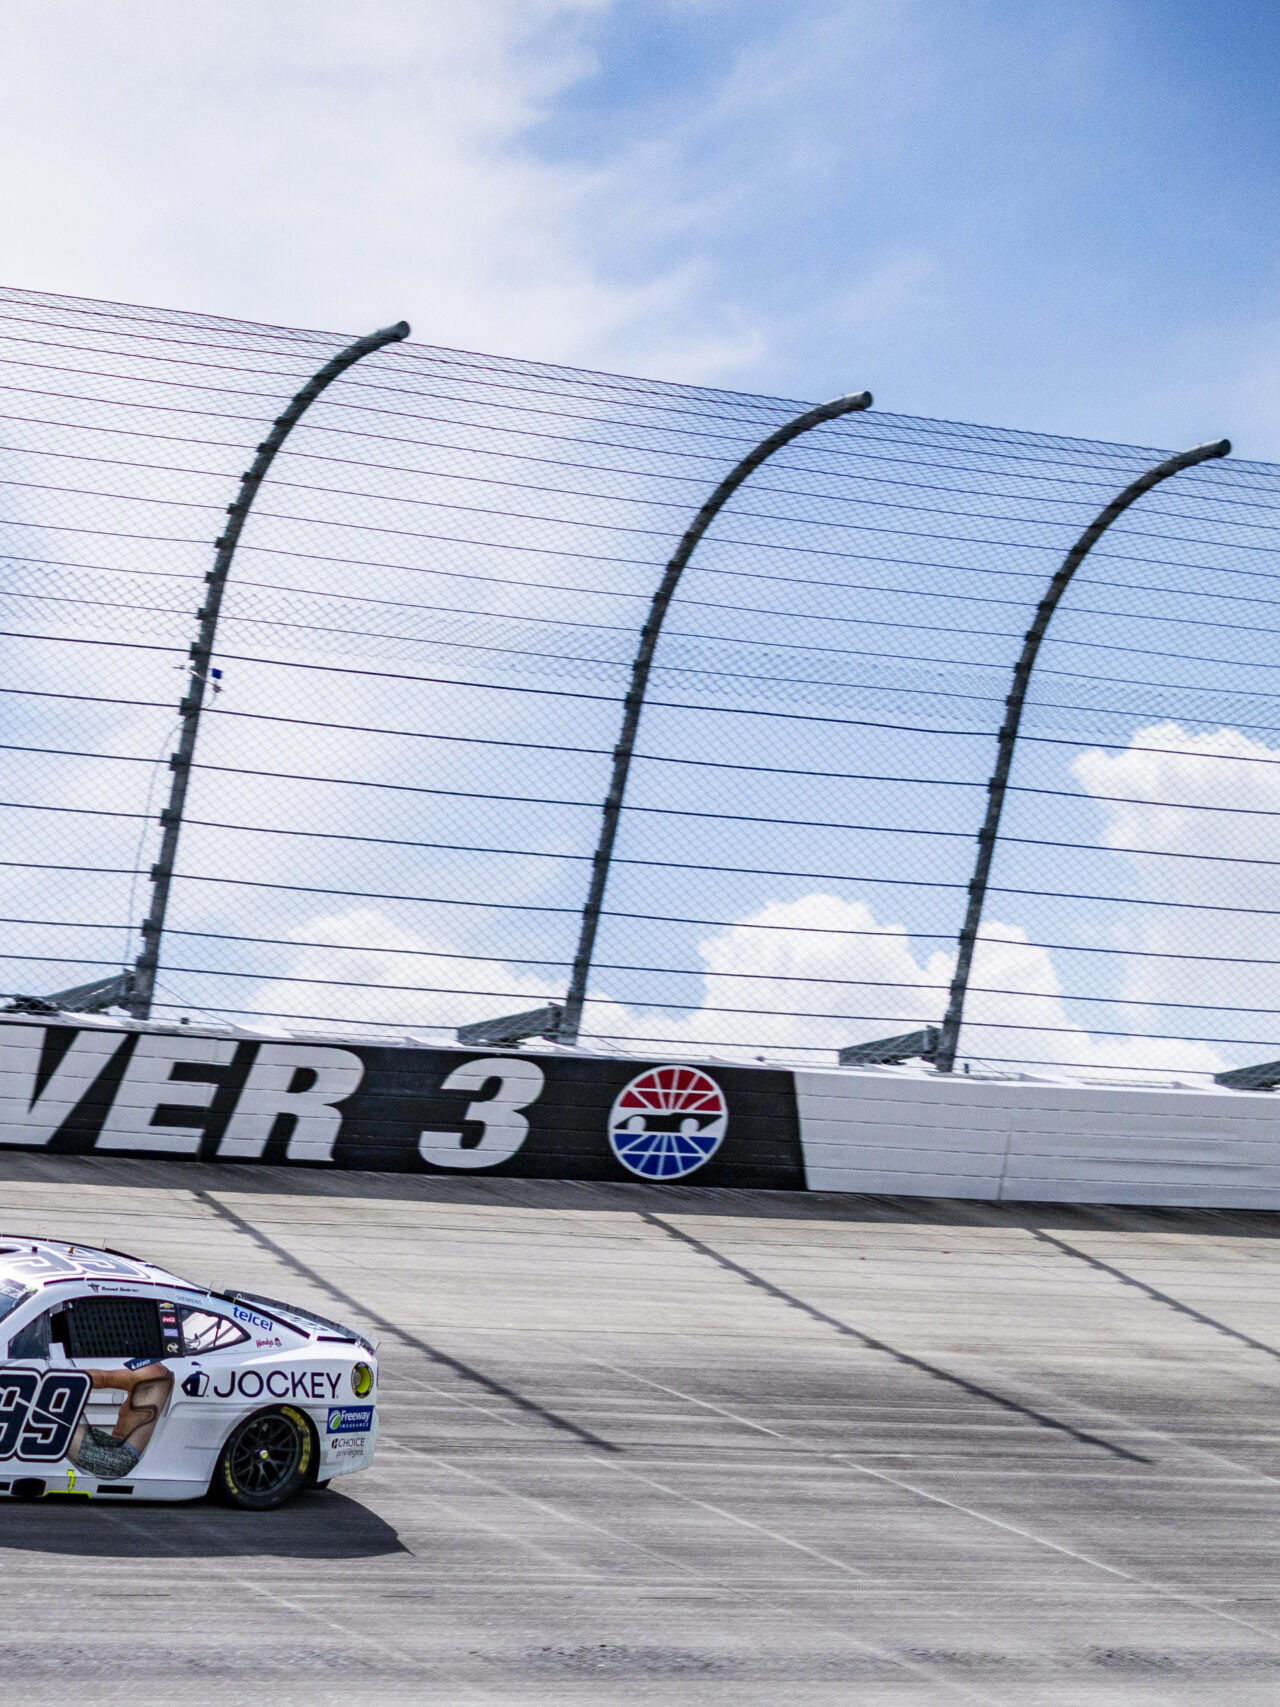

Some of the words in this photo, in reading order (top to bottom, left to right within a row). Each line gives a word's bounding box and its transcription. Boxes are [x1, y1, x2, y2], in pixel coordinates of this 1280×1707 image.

[418, 1056, 545, 1170] 3
[233, 1306, 273, 1331] telcel
[213, 1370, 342, 1399] JOCKEY
[341, 1410, 371, 1423] Freeway
[338, 1437, 366, 1448] CHOICE
